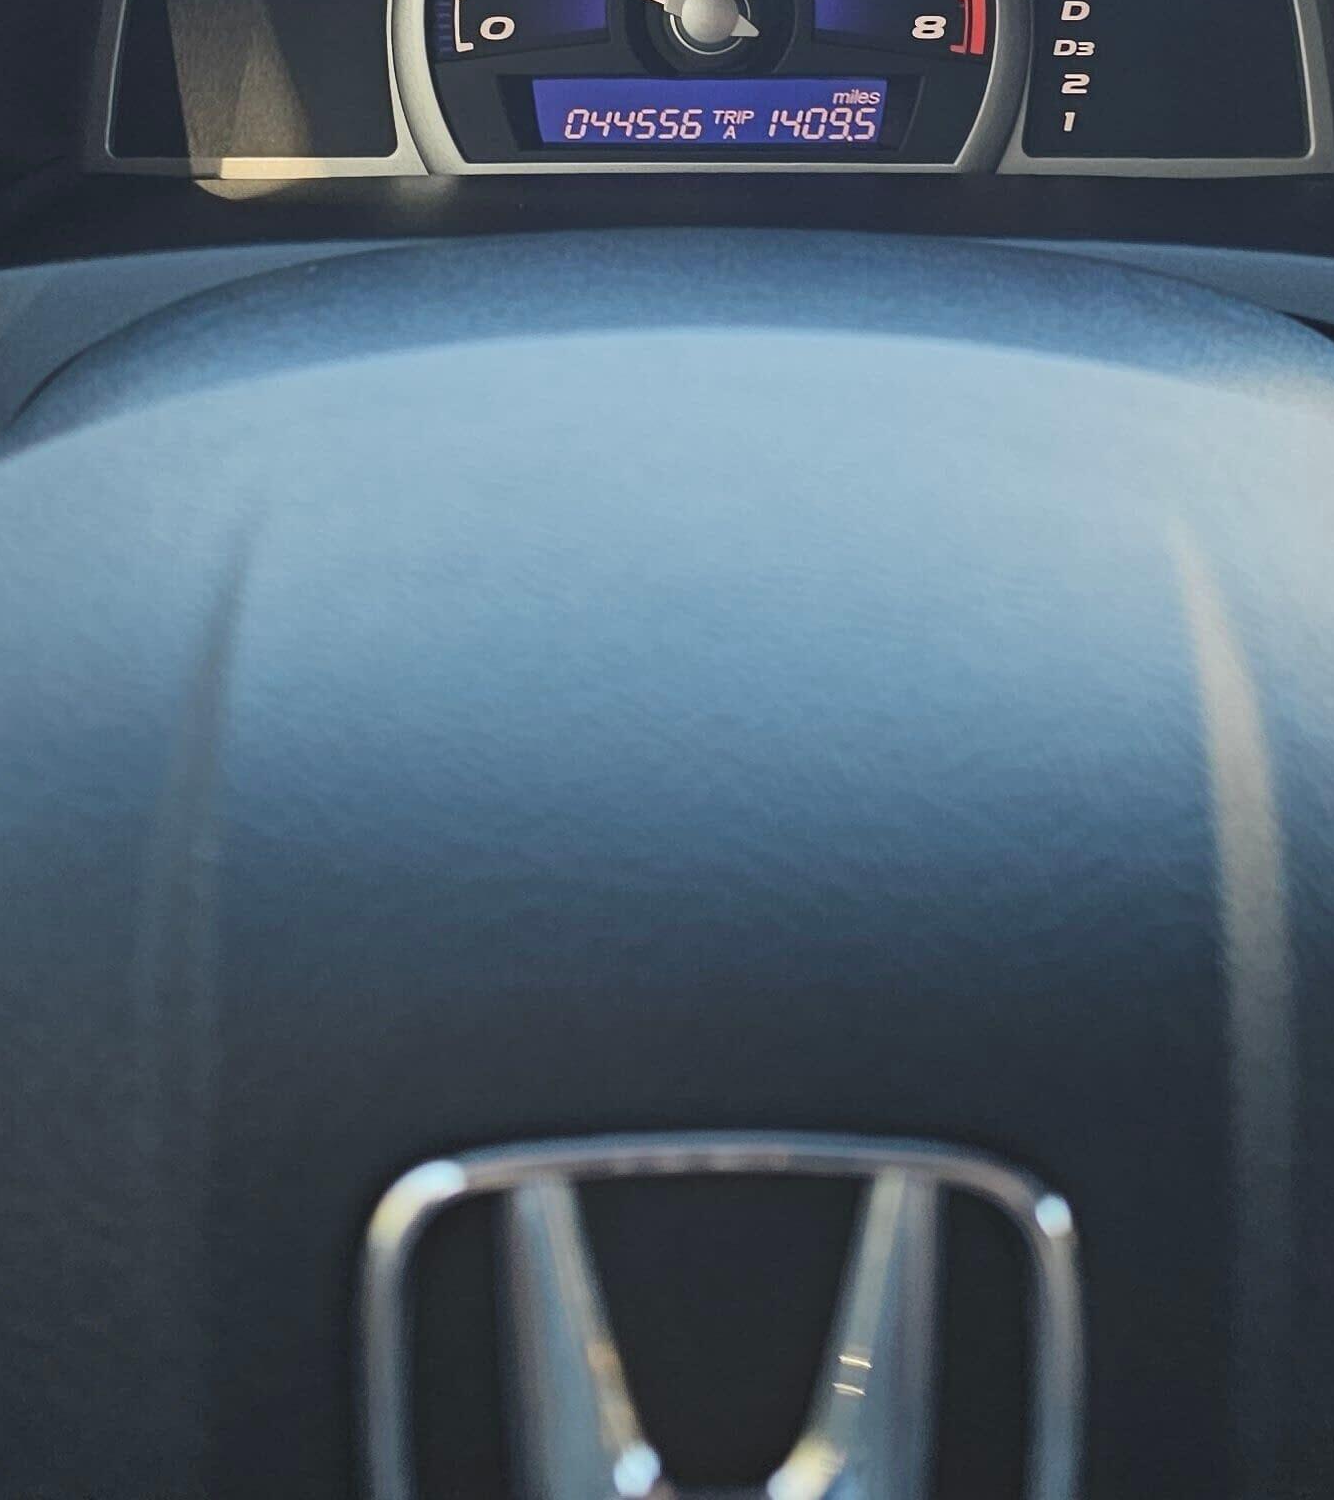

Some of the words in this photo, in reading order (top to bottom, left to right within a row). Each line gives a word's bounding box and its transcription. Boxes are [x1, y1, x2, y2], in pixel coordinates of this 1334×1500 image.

[1060, 0, 1090, 21] D
[479, 16, 515, 40] 0
[911, 15, 947, 39] 8
[1053, 39, 1096, 56] D3
[1061, 73, 1090, 94] 2
[832, 89, 881, 105] miles
[564, 108, 703, 140] 044556
[712, 109, 755, 125] TRIP
[767, 107, 876, 142] 1409.5
[1063, 111, 1076, 132] 1
[722, 127, 736, 140] A
